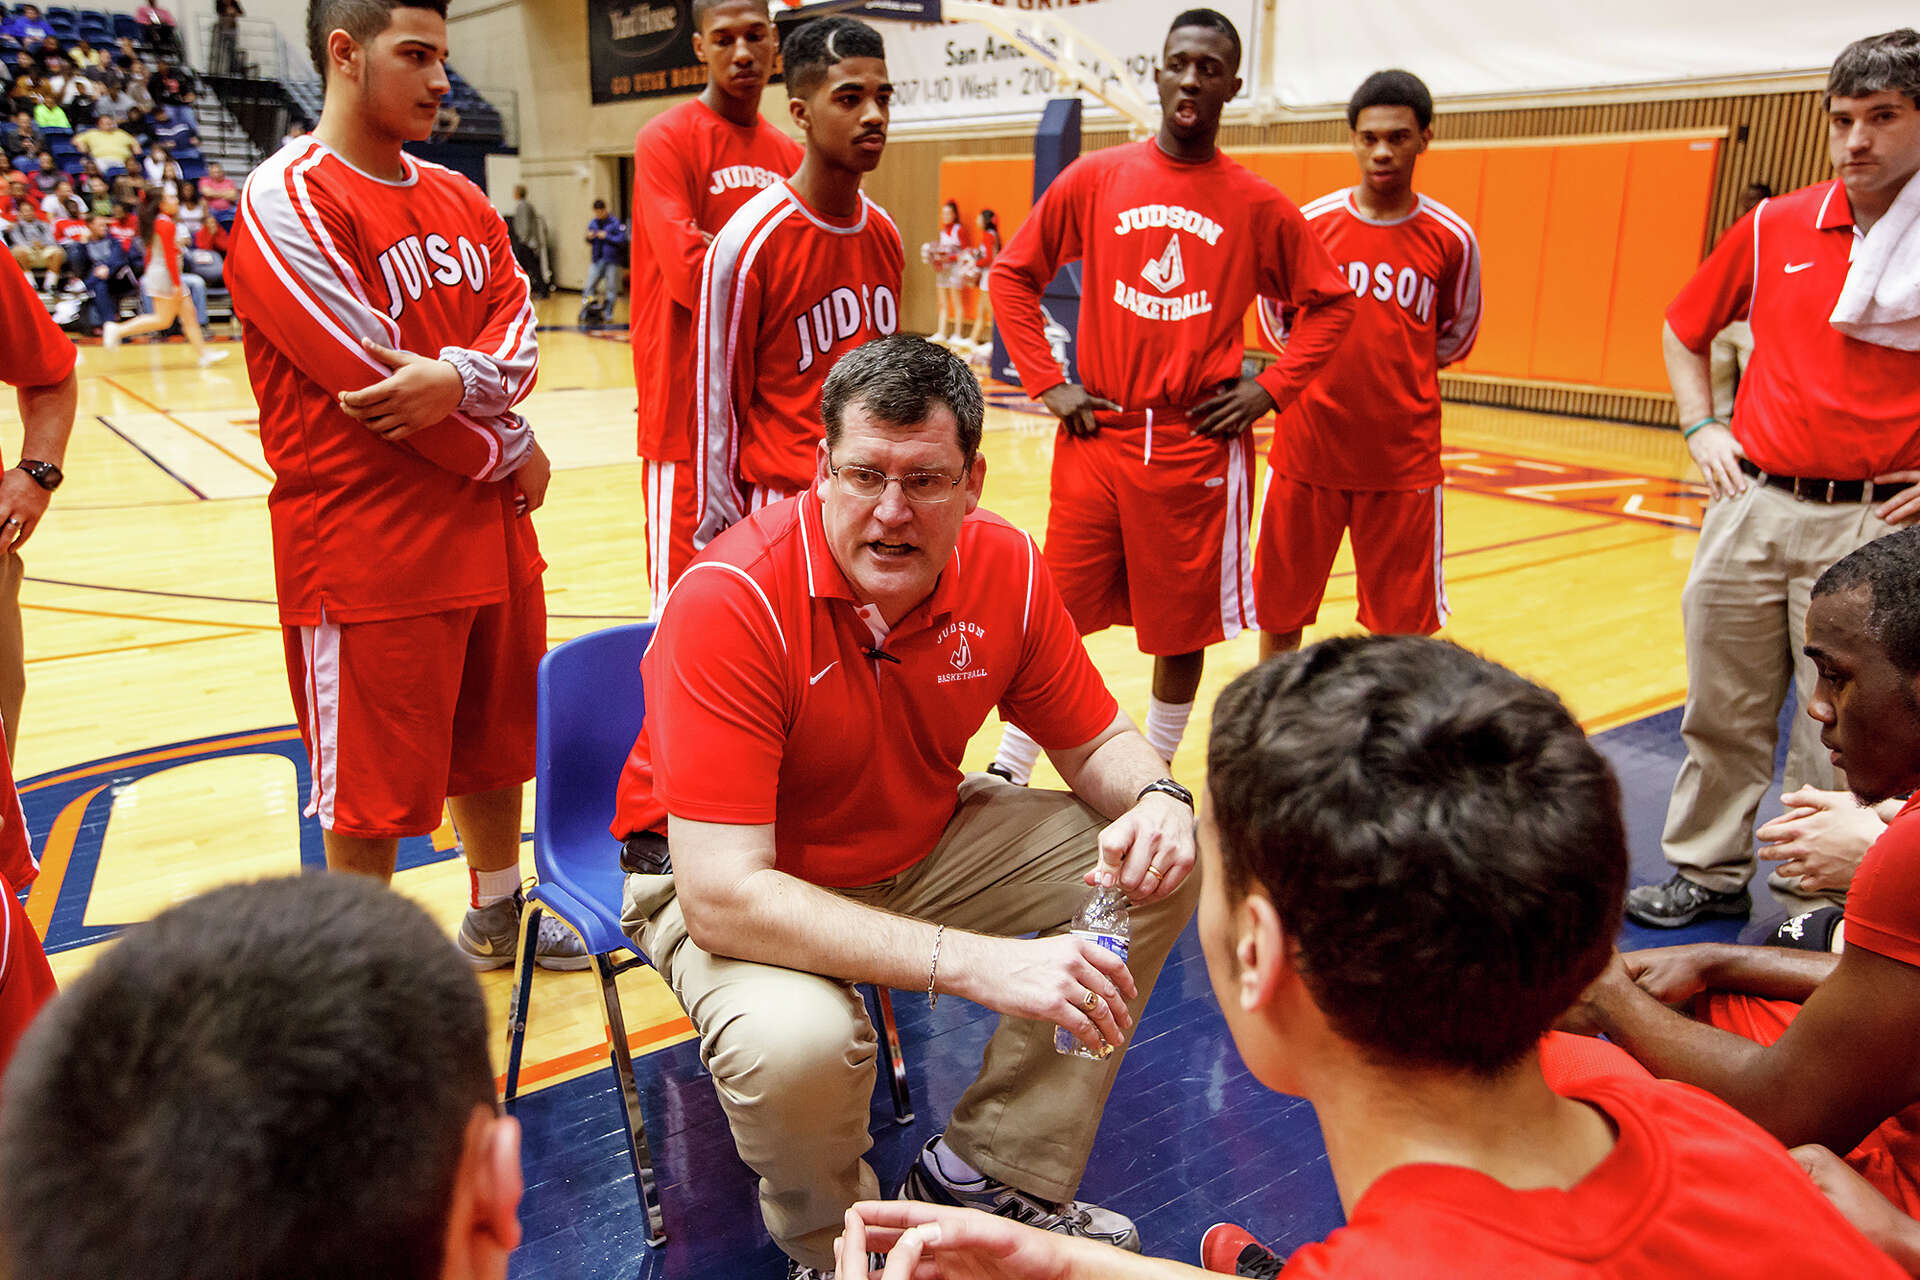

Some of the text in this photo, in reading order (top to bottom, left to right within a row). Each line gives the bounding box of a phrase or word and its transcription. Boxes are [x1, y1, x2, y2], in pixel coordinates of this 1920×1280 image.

[944, 36, 978, 67] San
[959, 74, 999, 99] West
[709, 164, 785, 195] JUDSO
[1114, 204, 1224, 246] JUDSON
[937, 621, 985, 644] JUDSON
[937, 668, 988, 684] BASKETBALL
